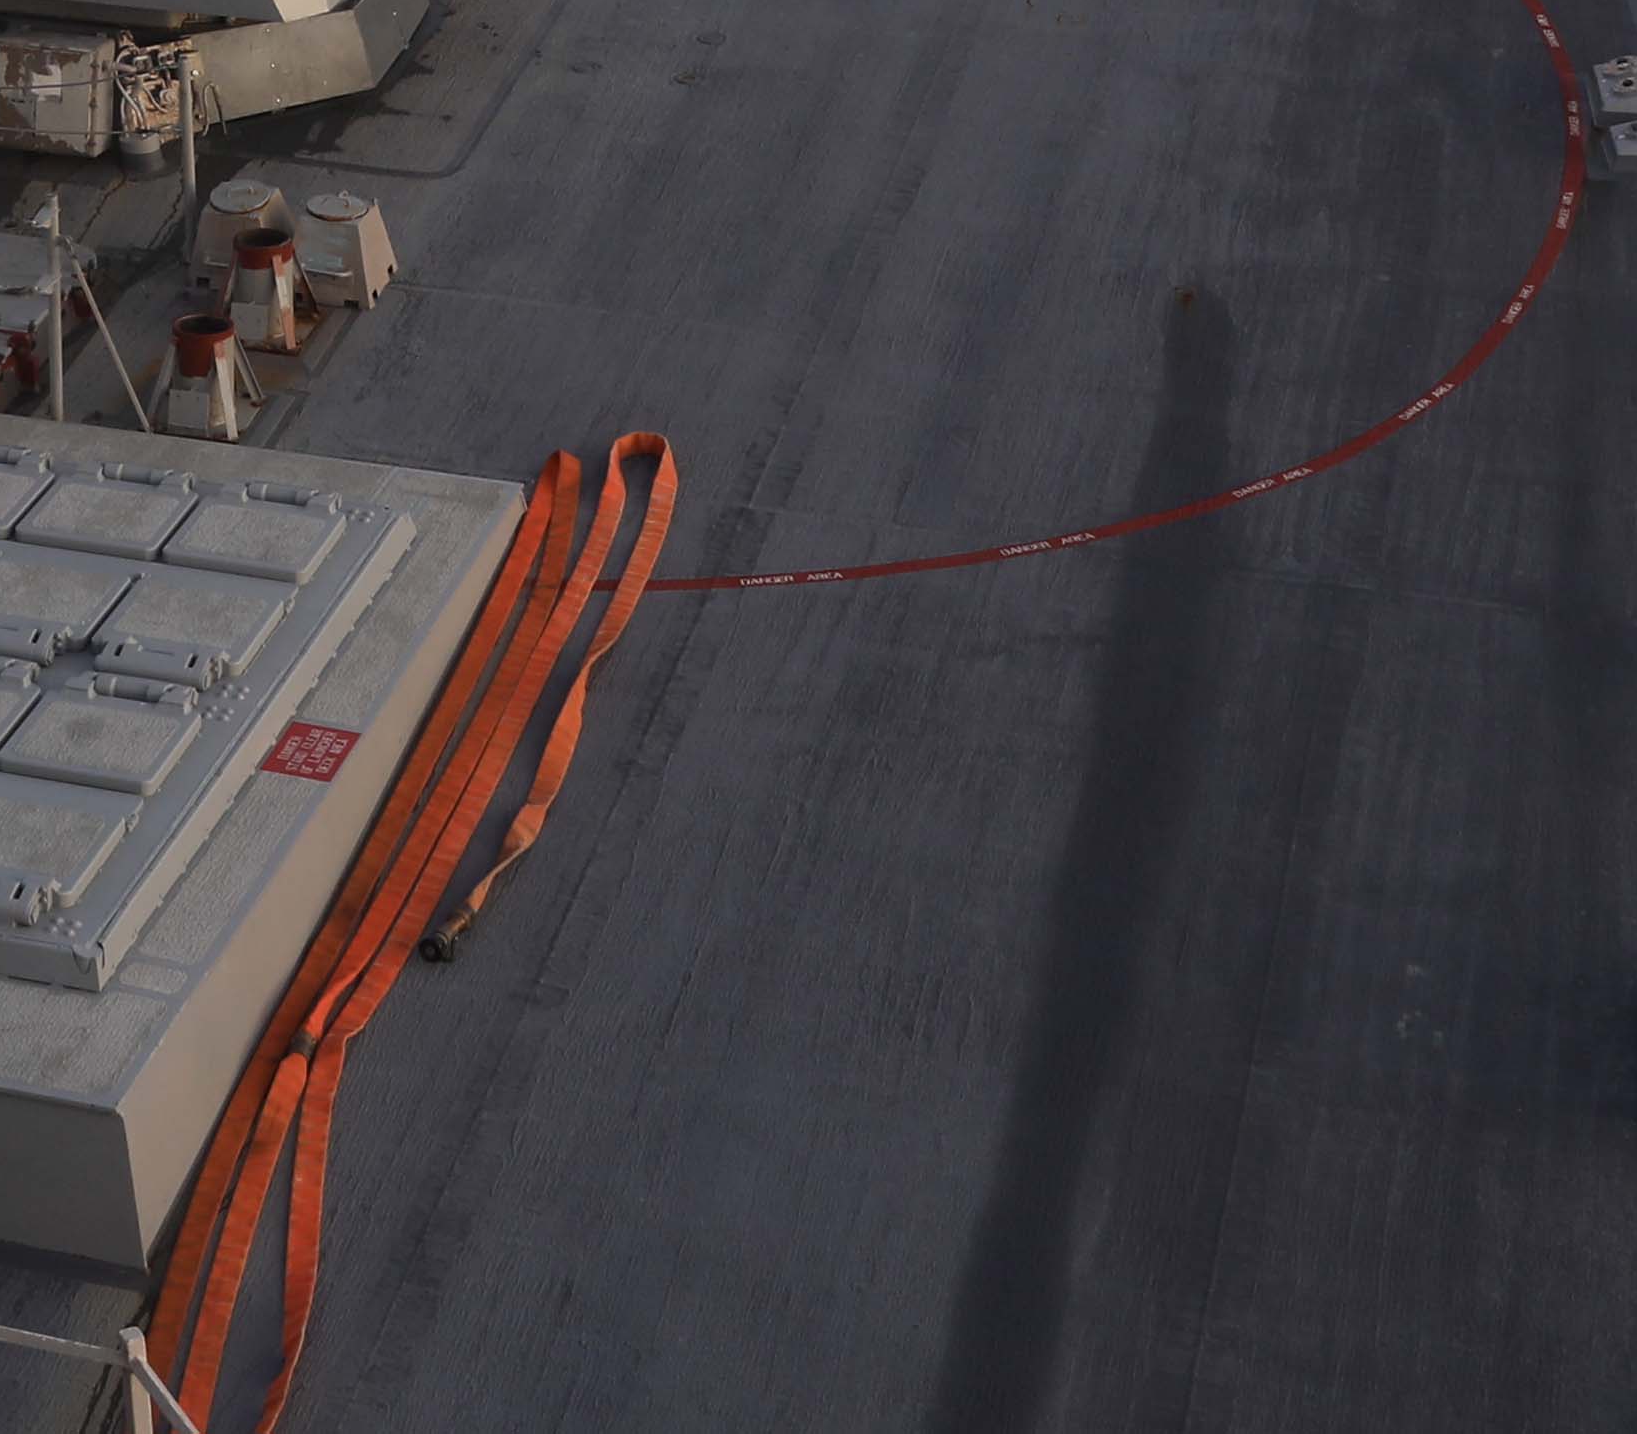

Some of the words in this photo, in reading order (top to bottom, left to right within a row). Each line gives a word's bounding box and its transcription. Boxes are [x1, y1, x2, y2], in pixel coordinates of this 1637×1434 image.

[1398, 397, 1432, 421] DANGER
[1431, 382, 1456, 398] AREA
[1231, 478, 1275, 500] DANGER
[1281, 465, 1313, 483] AREA
[1000, 539, 1051, 558] DANGER
[1060, 532, 1096, 545] AREA
[739, 574, 795, 587] DANGER
[806, 571, 844, 581] AREA
[276, 735, 303, 760] DANGER
[285, 749, 308, 771] STAND
[301, 728, 324, 749] CLEAR
[315, 755, 336, 773] DECK
[328, 738, 348, 754] AREA
